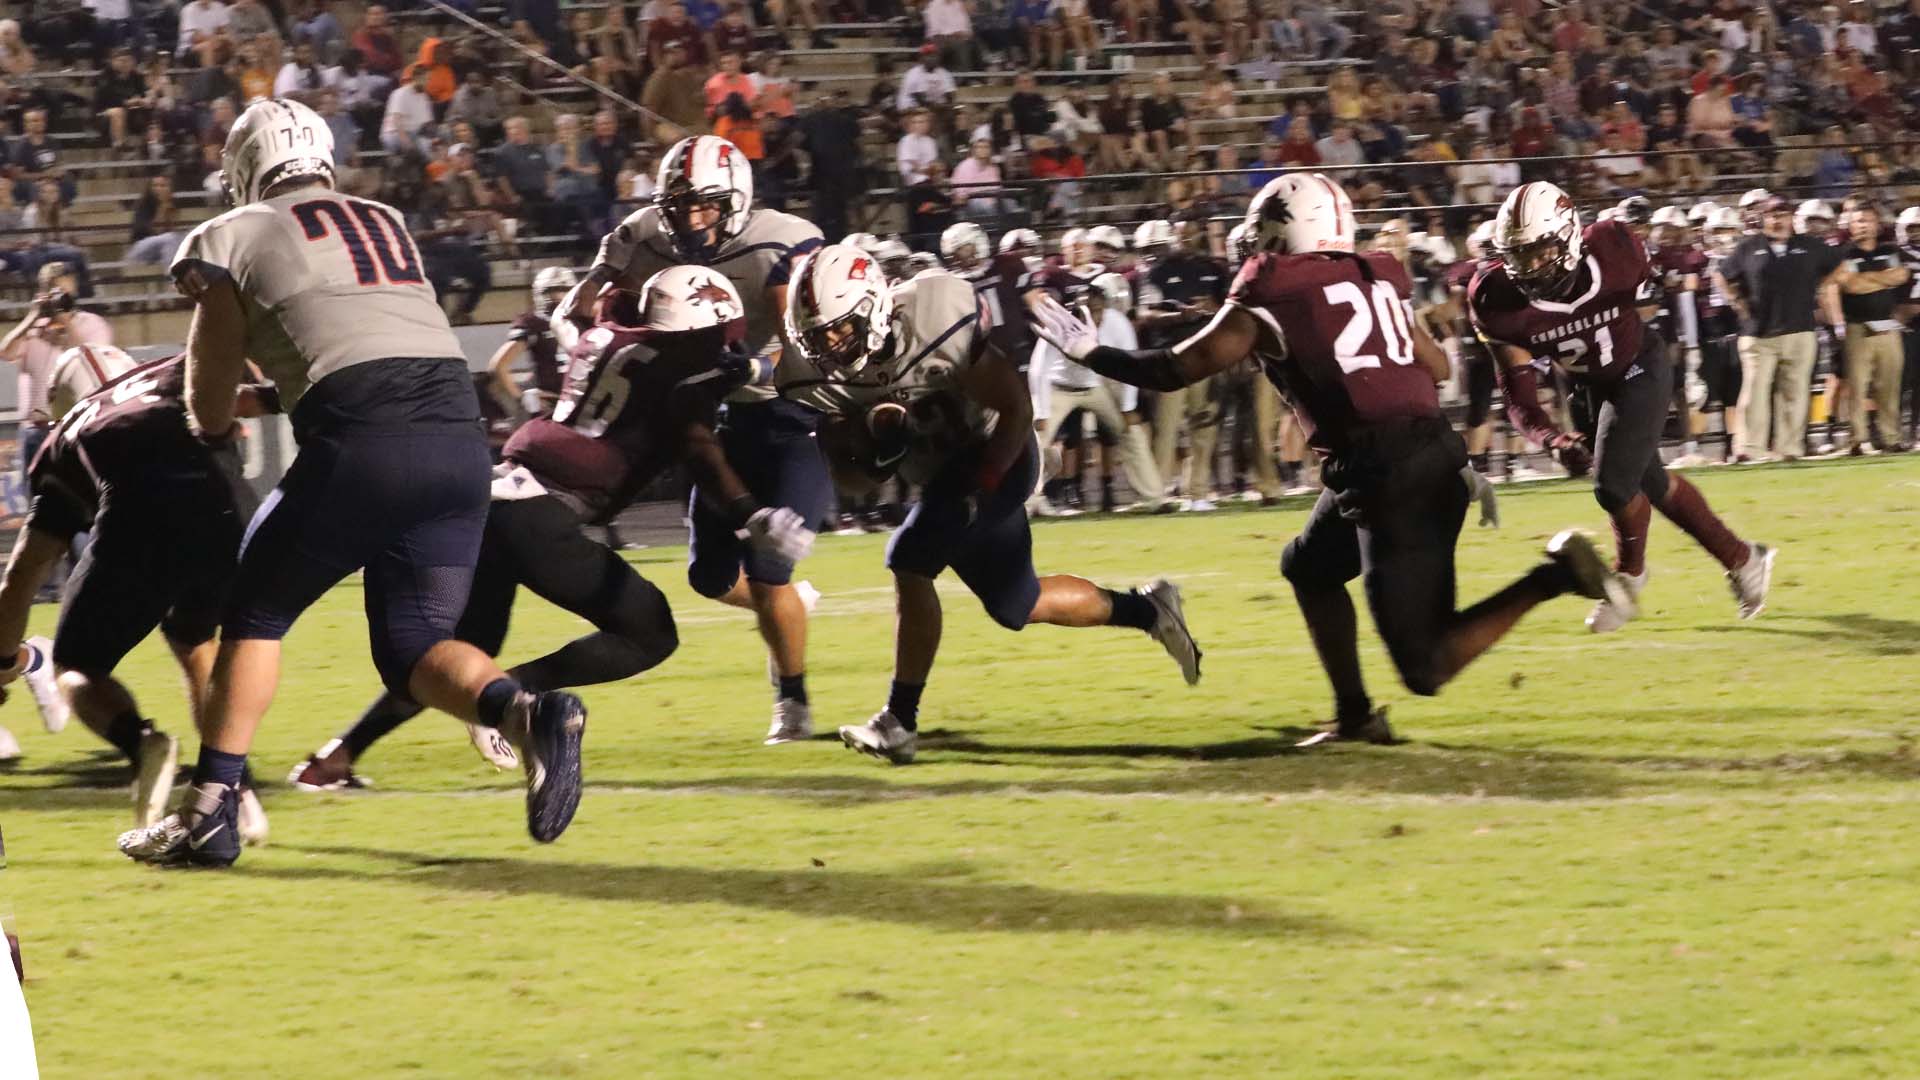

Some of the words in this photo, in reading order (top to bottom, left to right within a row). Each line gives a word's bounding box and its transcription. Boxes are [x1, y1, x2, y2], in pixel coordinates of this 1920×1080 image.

[290, 199, 425, 286] 70
[1322, 279, 1414, 374] 20
[1557, 326, 1614, 373] 21
